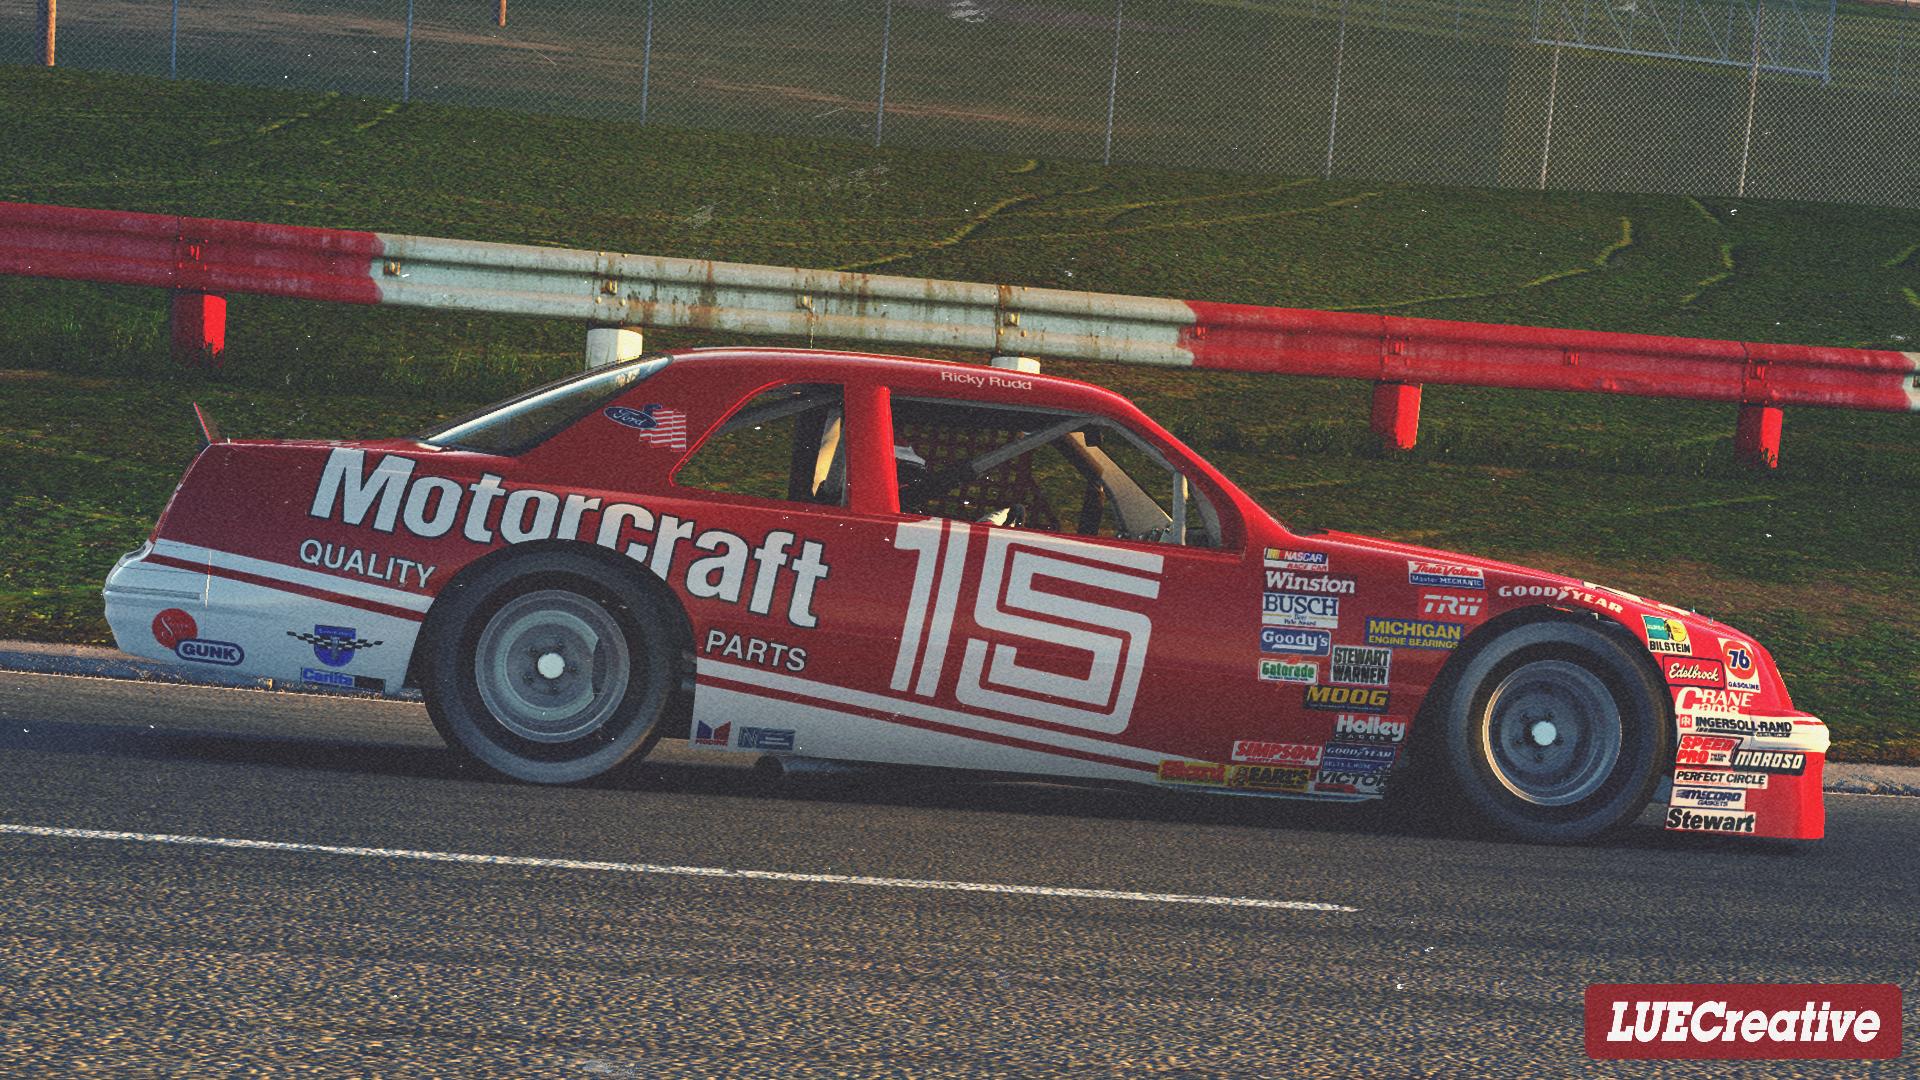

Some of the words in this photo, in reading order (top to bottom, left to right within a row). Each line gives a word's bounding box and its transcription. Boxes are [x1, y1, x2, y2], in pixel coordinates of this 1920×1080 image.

[941, 371, 985, 389] Ricky
[989, 375, 1032, 391] Rudd
[613, 409, 647, 426] Ford
[310, 447, 829, 628] Motorcraft
[300, 539, 436, 588] QUALITY
[1284, 552, 1323, 562] NASCAR
[1266, 570, 1356, 594] Winston
[1264, 593, 1338, 616] BUSCH
[1424, 594, 1483, 616] TRW
[1498, 585, 1623, 614] GOODYEAR
[889, 517, 1165, 734] 15
[1369, 620, 1462, 640] MICHIGAN
[705, 630, 807, 671] PARTS
[1262, 630, 1329, 651] Goody's
[1369, 636, 1407, 646] ENGINE
[1409, 638, 1459, 649] BEARINGS
[1649, 640, 1691, 653] BILSTEIN
[182, 643, 237, 660] GUNK
[1334, 646, 1389, 666] STEWART
[1727, 649, 1751, 669] 76
[1262, 662, 1315, 679] Gatorade
[1332, 665, 1386, 684] WARNER
[1669, 662, 1719, 682] Edelbrock
[1309, 686, 1389, 706] MOOG
[1728, 681, 1760, 691] GASOLINE
[1336, 715, 1406, 741] Holley
[1695, 716, 1793, 733] INGERSOLL-RAND
[1235, 742, 1320, 760] SIMPSON
[1680, 737, 1736, 751] SPEED
[1677, 750, 1709, 764] PRO
[1735, 751, 1804, 770] MOROSO
[1676, 770, 1725, 783] PERFECT
[1726, 773, 1766, 785] CIRCLE
[1697, 798, 1729, 806] GASKETS
[1667, 808, 1755, 833] Stewart
